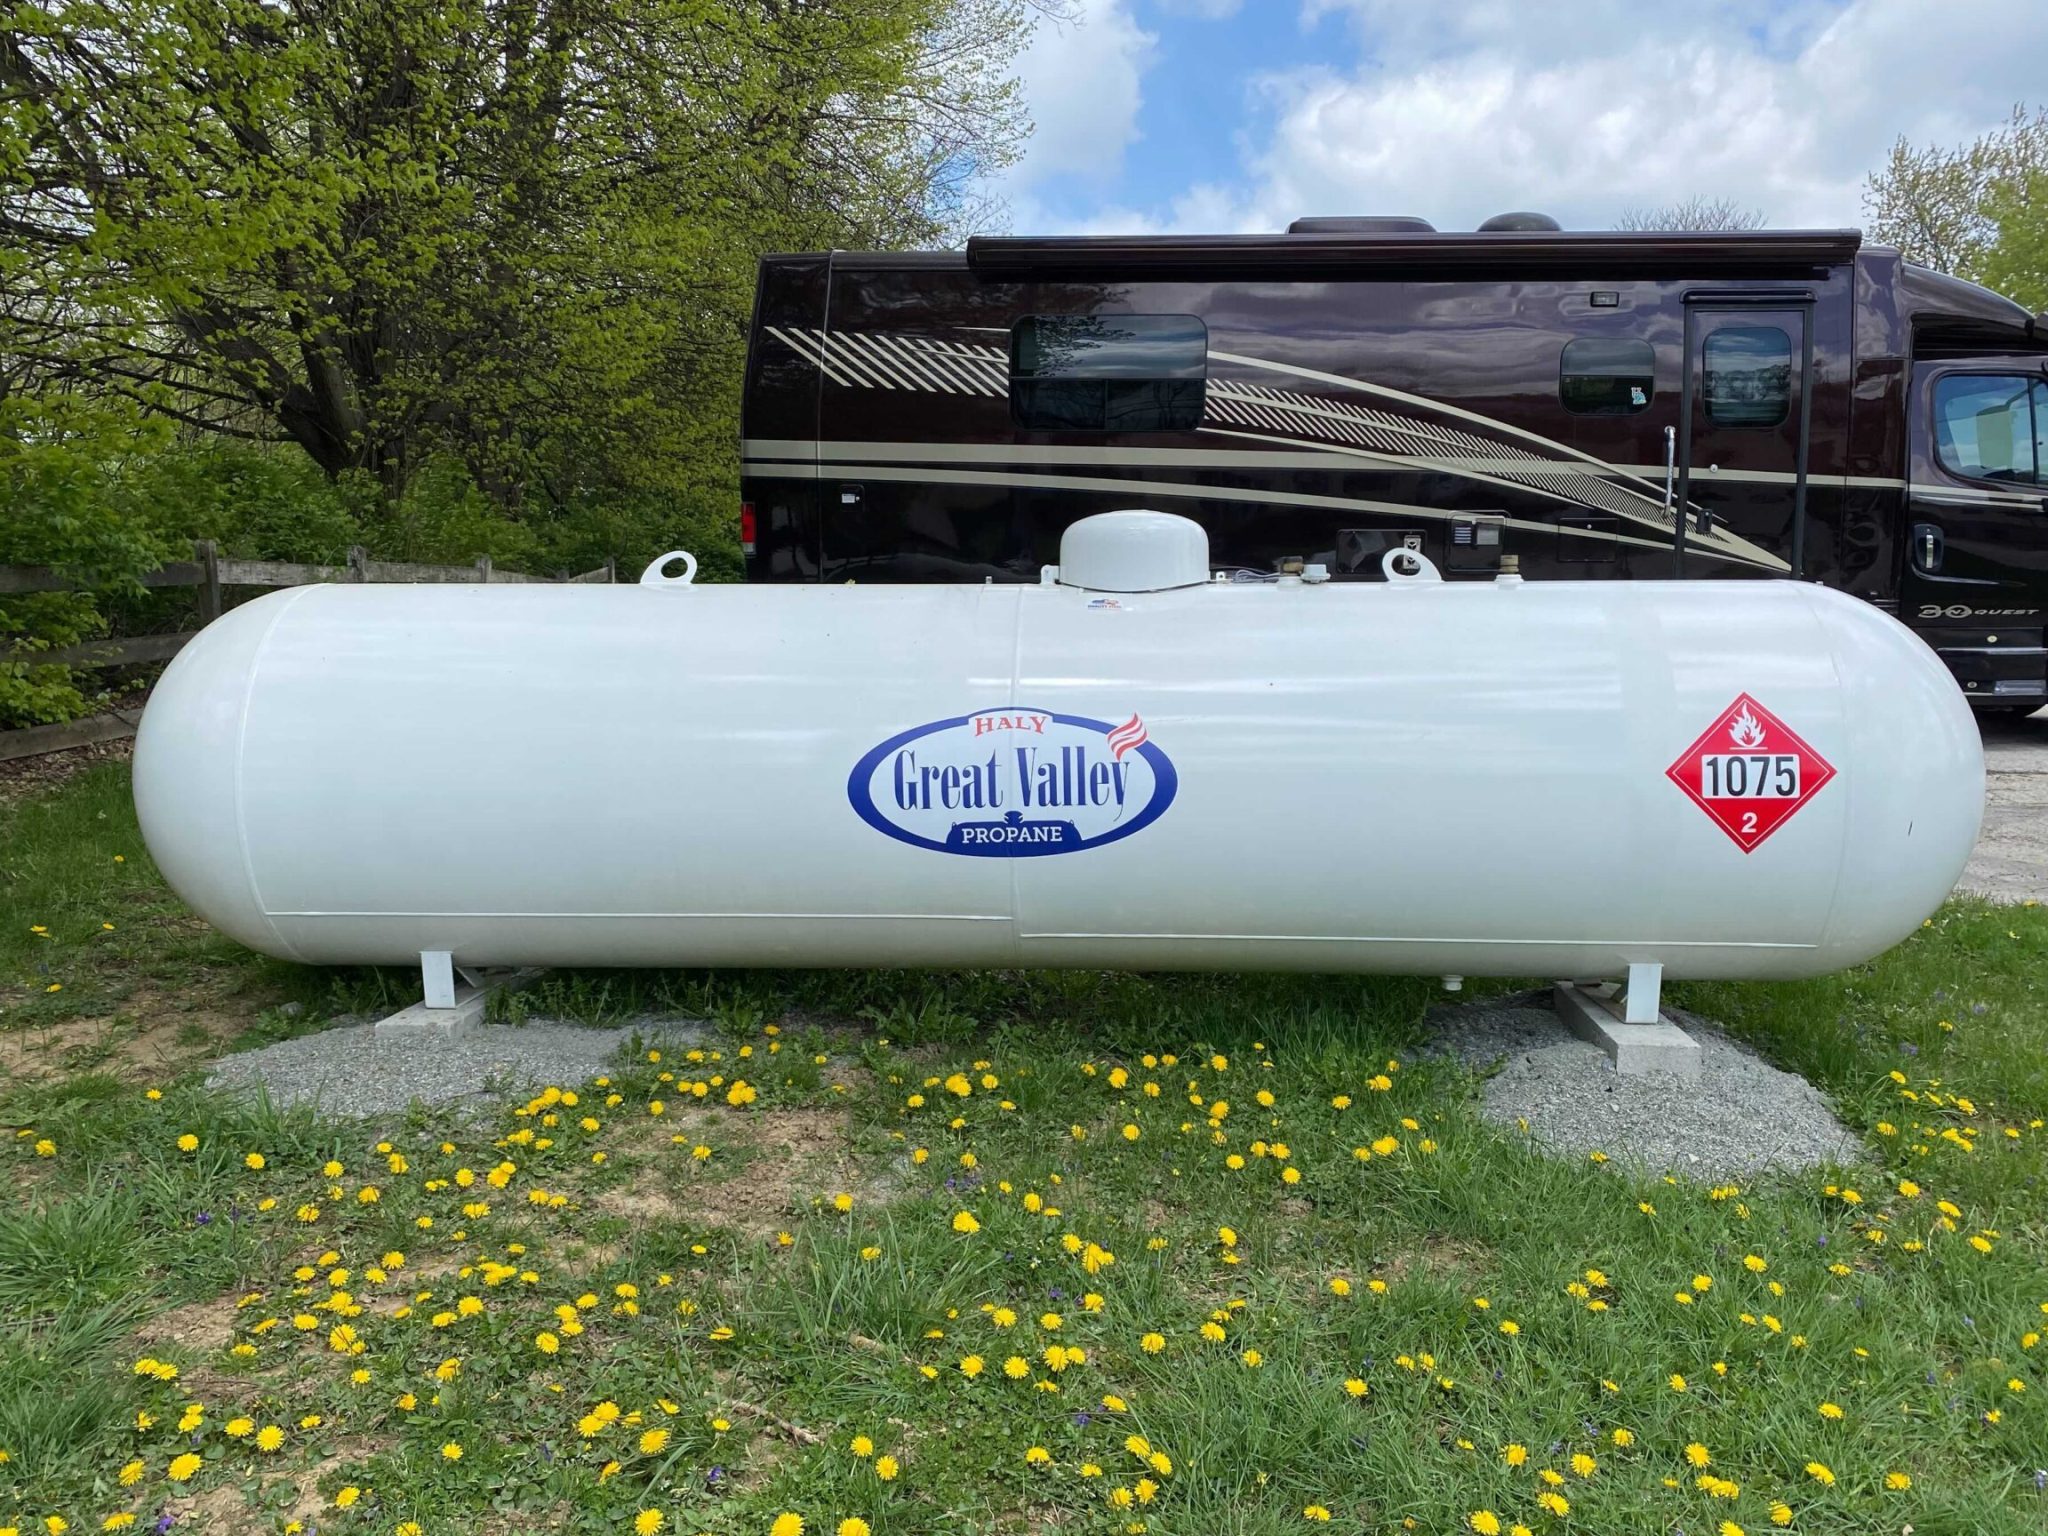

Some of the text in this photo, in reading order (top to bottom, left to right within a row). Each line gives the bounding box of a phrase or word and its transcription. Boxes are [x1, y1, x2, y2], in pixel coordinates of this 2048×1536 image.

[1974, 608, 2040, 616] QUEST
[974, 715, 1048, 737] HALY
[893, 745, 1131, 822] Great Valley
[1706, 756, 1796, 797] 1075
[1741, 811, 1758, 833] 2
[961, 825, 1063, 845] PROPANE
